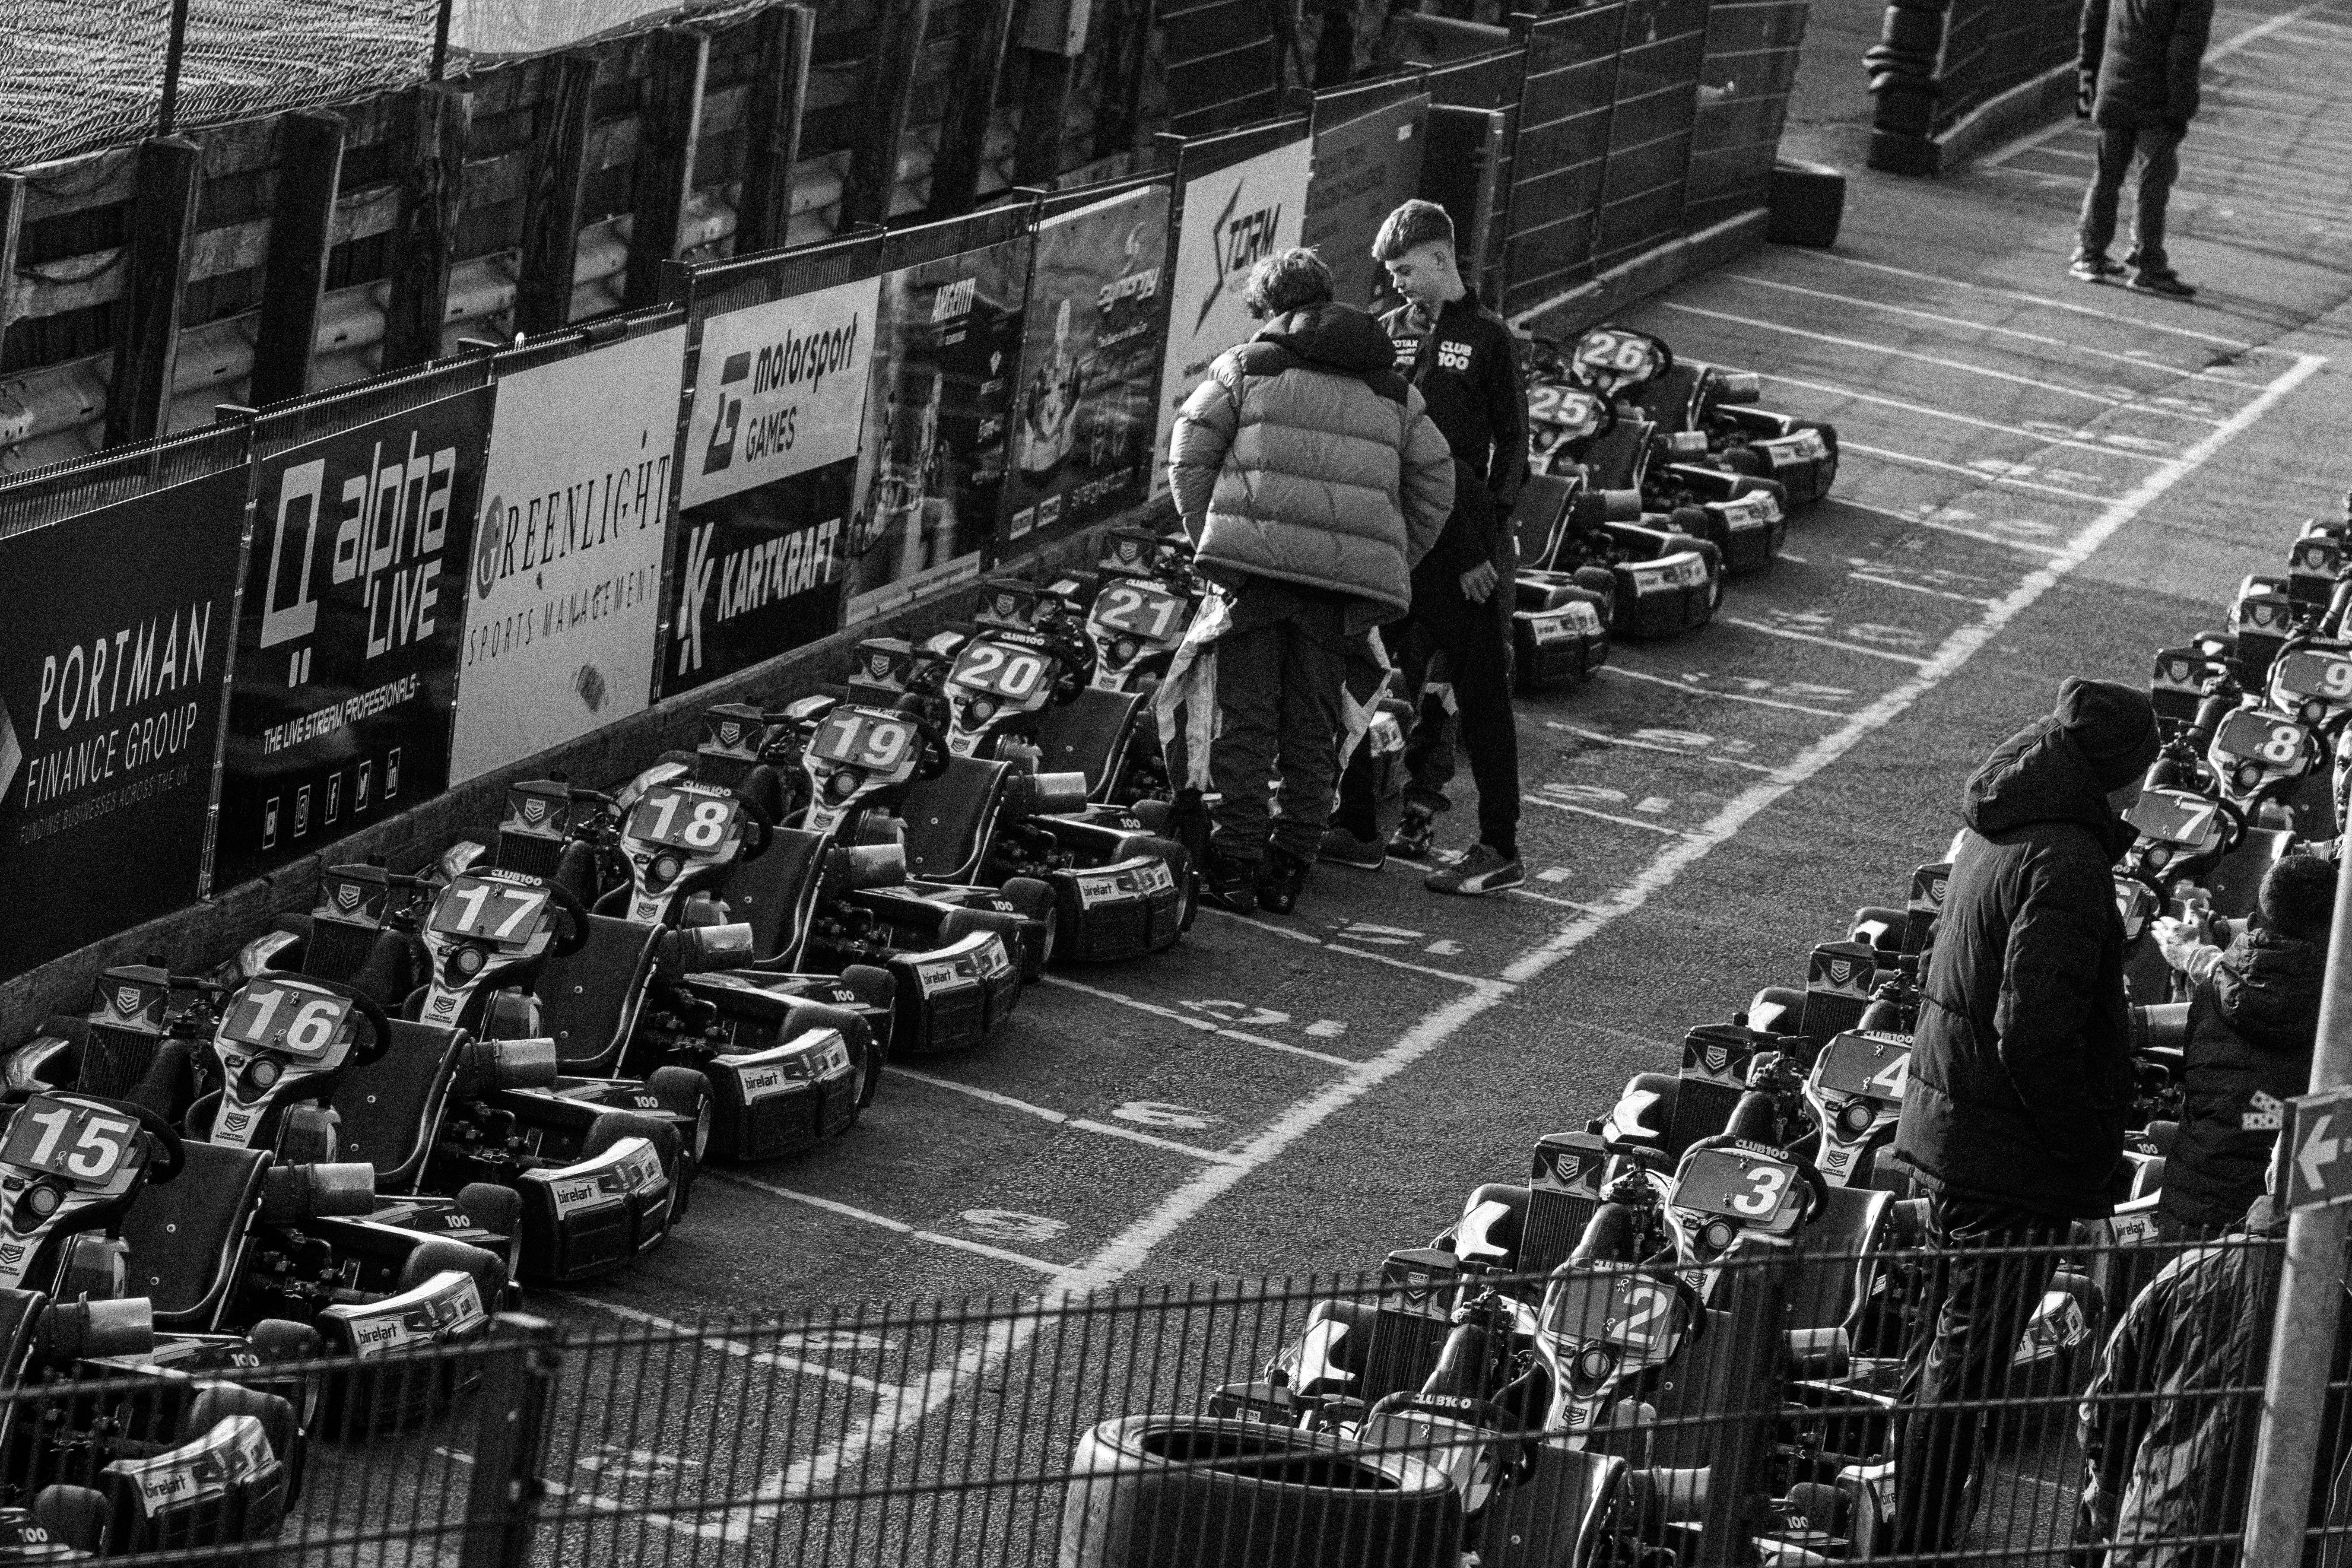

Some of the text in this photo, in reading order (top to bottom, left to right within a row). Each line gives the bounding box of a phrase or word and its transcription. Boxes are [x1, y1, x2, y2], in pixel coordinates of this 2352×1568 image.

[753, 312, 857, 394] motorsport
[1438, 352, 1469, 370] 100
[1441, 341, 1472, 356] CLUB
[1582, 333, 1647, 370] 26
[1529, 388, 1590, 424] 25
[746, 406, 797, 462] GAMES
[333, 430, 456, 608] alpha
[478, 454, 670, 592] GREENLIGHT
[717, 517, 840, 622] KARTKRAFT
[366, 559, 441, 659] LIVE
[468, 565, 656, 666] SPORTS MANAGEMENT
[1099, 588, 1177, 636] 21
[1001, 632, 1045, 646] CLUB100
[35, 601, 210, 740] PORTMAN
[955, 646, 1041, 694] 20
[2323, 662, 2352, 696] 9
[264, 673, 416, 755] THE LIVE STREAM PROFESSIONALS
[25, 701, 197, 809] FINANCE GROUP
[833, 716, 906, 765] 19
[2263, 726, 2301, 762] 8
[682, 780, 732, 797] CLUB100
[650, 794, 729, 847] 18
[1120, 818, 1141, 828] 100
[2175, 802, 2216, 840] 7
[491, 868, 543, 887] CLUB100
[1084, 883, 1112, 897] birelart
[456, 885, 545, 938] 17
[991, 900, 1013, 911] 100
[832, 990, 855, 1001] 100
[924, 970, 952, 985] birelart
[245, 989, 341, 1051] 16
[1864, 1030, 1914, 1044] CLUB100
[746, 1072, 778, 1090] birelart
[1872, 1052, 1911, 1098] 4
[634, 1095, 659, 1109] 100
[30, 1108, 130, 1177] 15
[1735, 1139, 1789, 1160] CLUB100
[2137, 1143, 2158, 1155] 100
[556, 1185, 593, 1204] birelart
[1733, 1167, 1785, 1215] 3
[445, 1214, 471, 1228] 100
[358, 1323, 397, 1344] birelart
[1611, 1288, 1667, 1345] 2
[230, 1353, 260, 1367] 100
[143, 1475, 186, 1499] birelart
[19, 1527, 48, 1542] 100
[1787, 1516, 1809, 1529] 100
